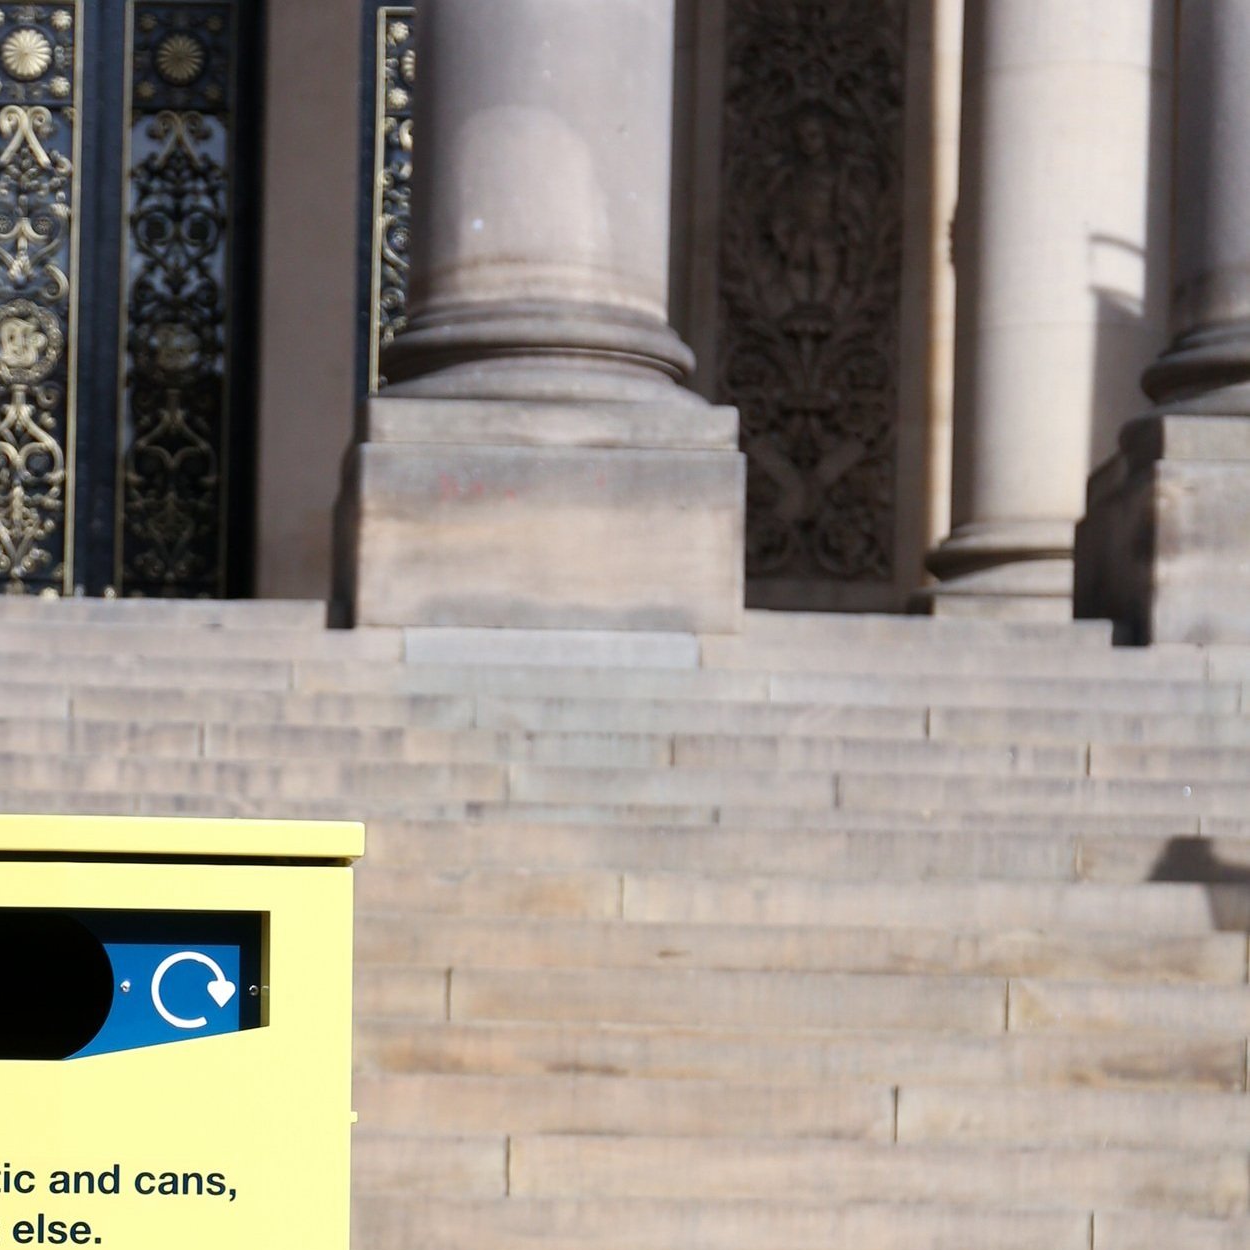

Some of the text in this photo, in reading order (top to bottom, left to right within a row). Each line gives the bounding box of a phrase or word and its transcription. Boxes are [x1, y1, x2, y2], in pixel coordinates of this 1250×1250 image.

[48, 1163, 120, 1195] and
[134, 1171, 237, 1202] cans,
[12, 1213, 102, 1245] else.
